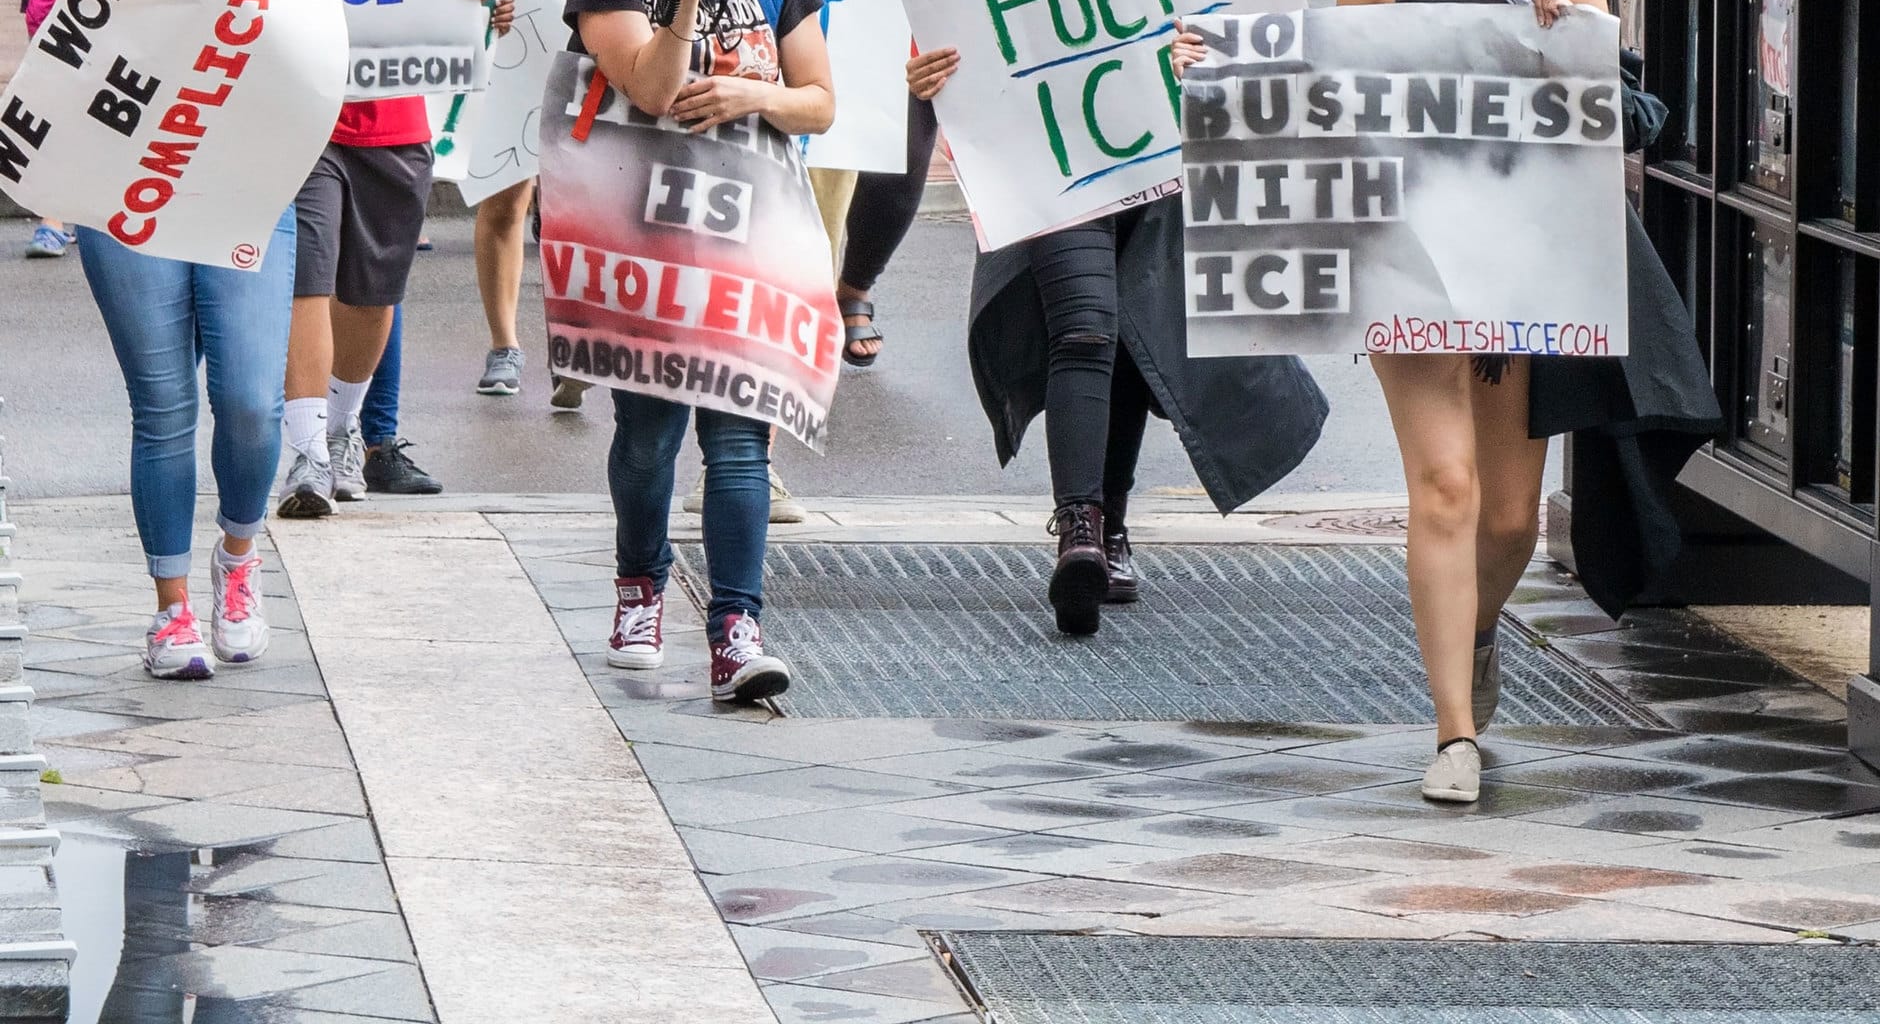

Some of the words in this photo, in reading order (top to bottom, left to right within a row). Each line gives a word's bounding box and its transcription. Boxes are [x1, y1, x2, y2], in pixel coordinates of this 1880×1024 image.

[1186, 14, 1296, 59] NO
[87, 55, 161, 138] BE
[347, 56, 473, 88] CECOH
[653, 168, 745, 233] IS
[1186, 161, 1400, 222] WITH
[541, 242, 838, 371] VIOLENCE
[1195, 253, 1339, 312] ICE
[1365, 315, 1609, 356] @ABOLISHICECOH
